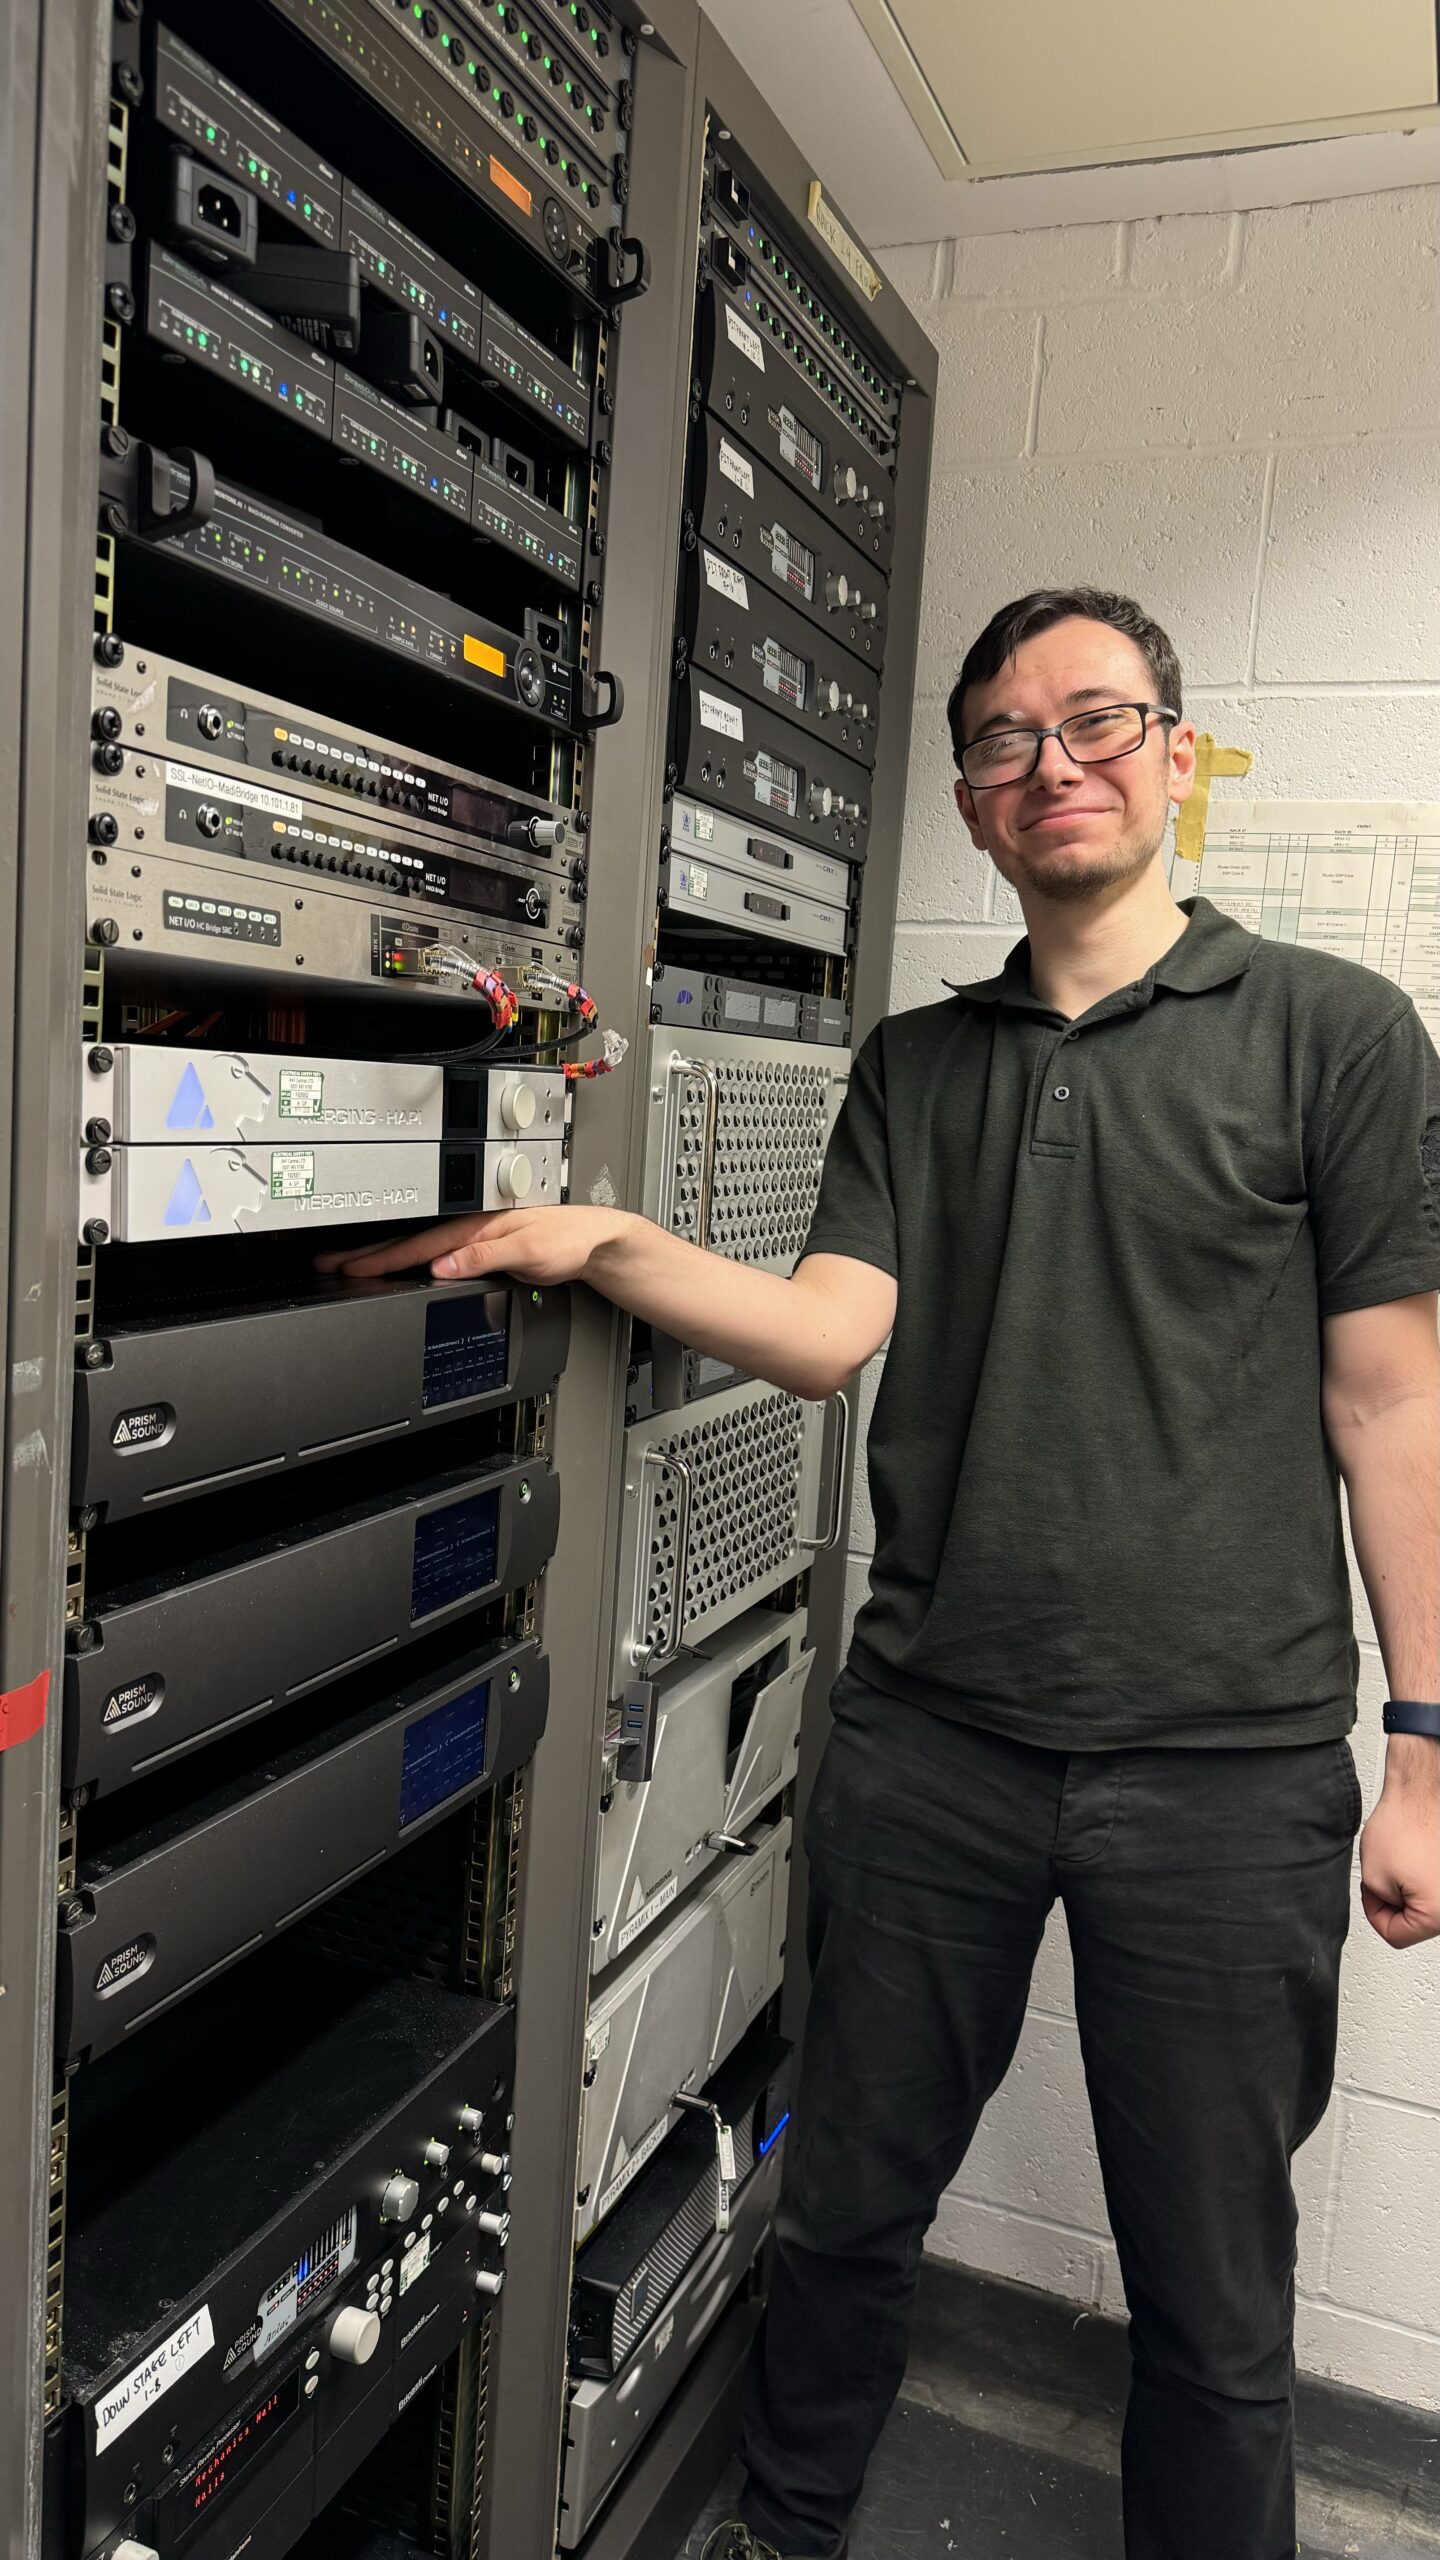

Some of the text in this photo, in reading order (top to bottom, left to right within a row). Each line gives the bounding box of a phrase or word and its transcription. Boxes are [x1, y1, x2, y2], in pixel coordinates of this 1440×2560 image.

[97, 677, 113, 688] Solid
[114, 682, 129, 693] State
[95, 784, 111, 795] Solid
[112, 788, 128, 799] State
[170, 767, 299, 814] SSL-NetIO-MadiBridge 10.101.1.81
[428, 792, 449, 806] NET I/O
[425, 872, 446, 885] NET I/O
[92, 885, 143, 901] Solid State Logic
[169, 915, 183, 927] NET
[184, 917, 196, 929] I/O
[197, 921, 206, 931] HC
[206, 924, 221, 934] Bridge
[222, 926, 233, 935] SRC
[386, 1109, 423, 1125] HAPI
[294, 1191, 373, 1211] MERGING
[383, 1187, 419, 1204] HAPI
[128, 1413, 157, 1429] PRISM
[131, 1423, 165, 1440] SOUND
[119, 1683, 146, 1704] PRISM
[121, 1692, 153, 1713] SOUND
[645, 1868, 673, 1899] MERGING
[621, 1908, 649, 1945] PYRAMIX
[660, 1882, 675, 1906] MAIN
[111, 1944, 138, 1968] PRISM
[114, 1951, 146, 1977] SOUND
[602, 2168, 631, 2211] PYRAMIX
[641, 2121, 666, 2158] BACKUP
[234, 2322, 256, 2350] PRISM
[236, 2327, 262, 2356] SOUND
[133, 2350, 167, 2394] STAGE
[170, 2316, 201, 2357] LEFT
[144, 2377, 161, 2401] 1-8
[256, 2394, 277, 2424] Hall
